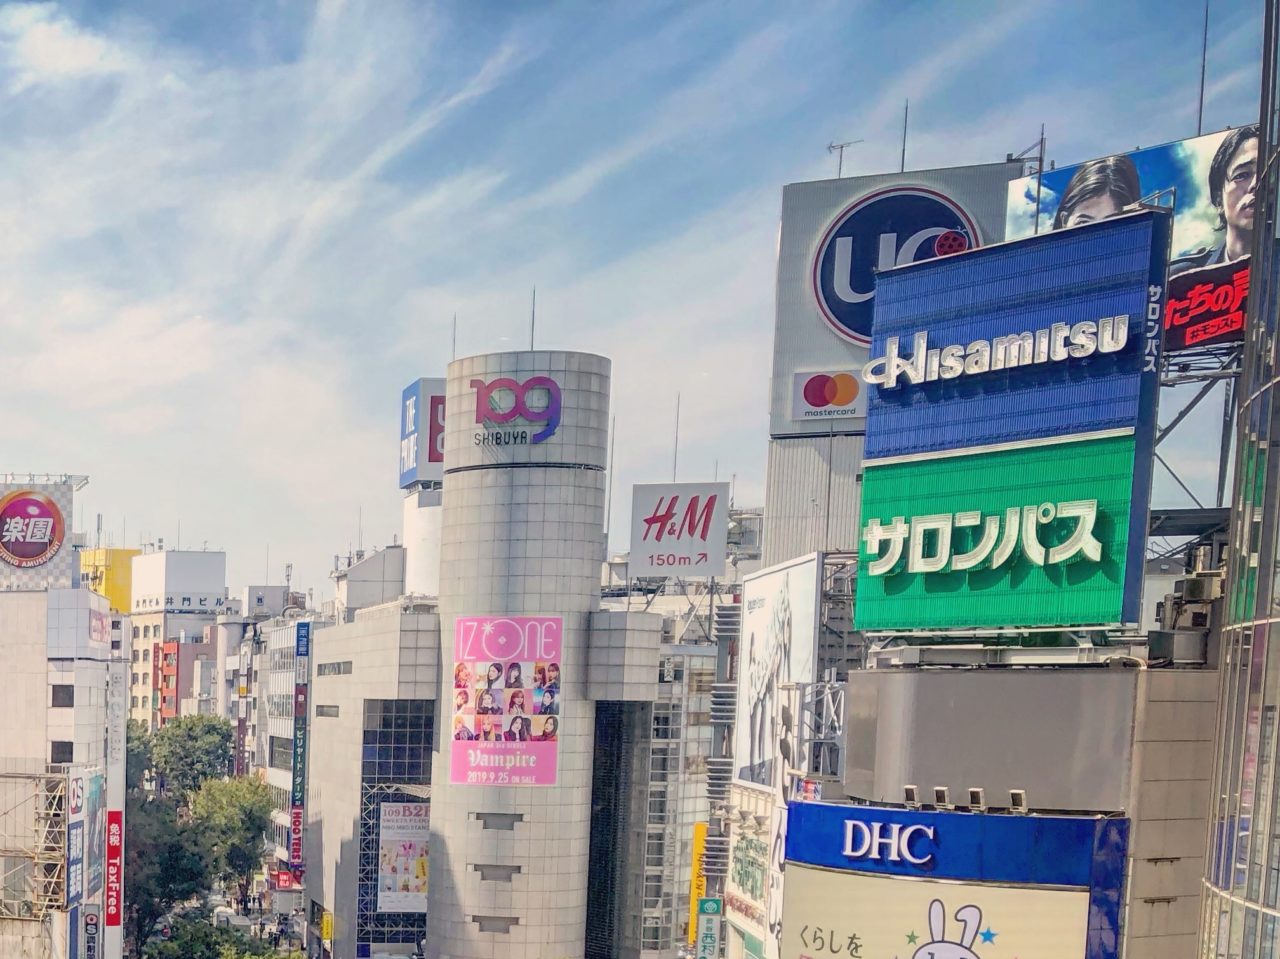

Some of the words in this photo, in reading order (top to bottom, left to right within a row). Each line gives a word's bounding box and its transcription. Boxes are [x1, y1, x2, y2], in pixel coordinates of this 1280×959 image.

[1143, 284, 1163, 373] サロンパス
[862, 314, 1130, 390] Hisamitsu
[470, 375, 562, 444] 109
[804, 407, 857, 418] mastercard
[474, 431, 528, 446] SHIBUYA
[1, 516, 54, 542] 楽園
[643, 494, 718, 542] H&M
[862, 498, 1103, 577] サロンパス
[21, 540, 61, 567] AMUSEMENT
[648, 553, 691, 567] 150m
[165, 597, 225, 607] 井門ビル
[468, 749, 537, 769] Vampire
[468, 771, 509, 784] 2019.9.25
[384, 808, 400, 818] 109
[292, 811, 302, 861] HOOTERS
[842, 819, 935, 864] DHC
[799, 924, 864, 959] くらしを
